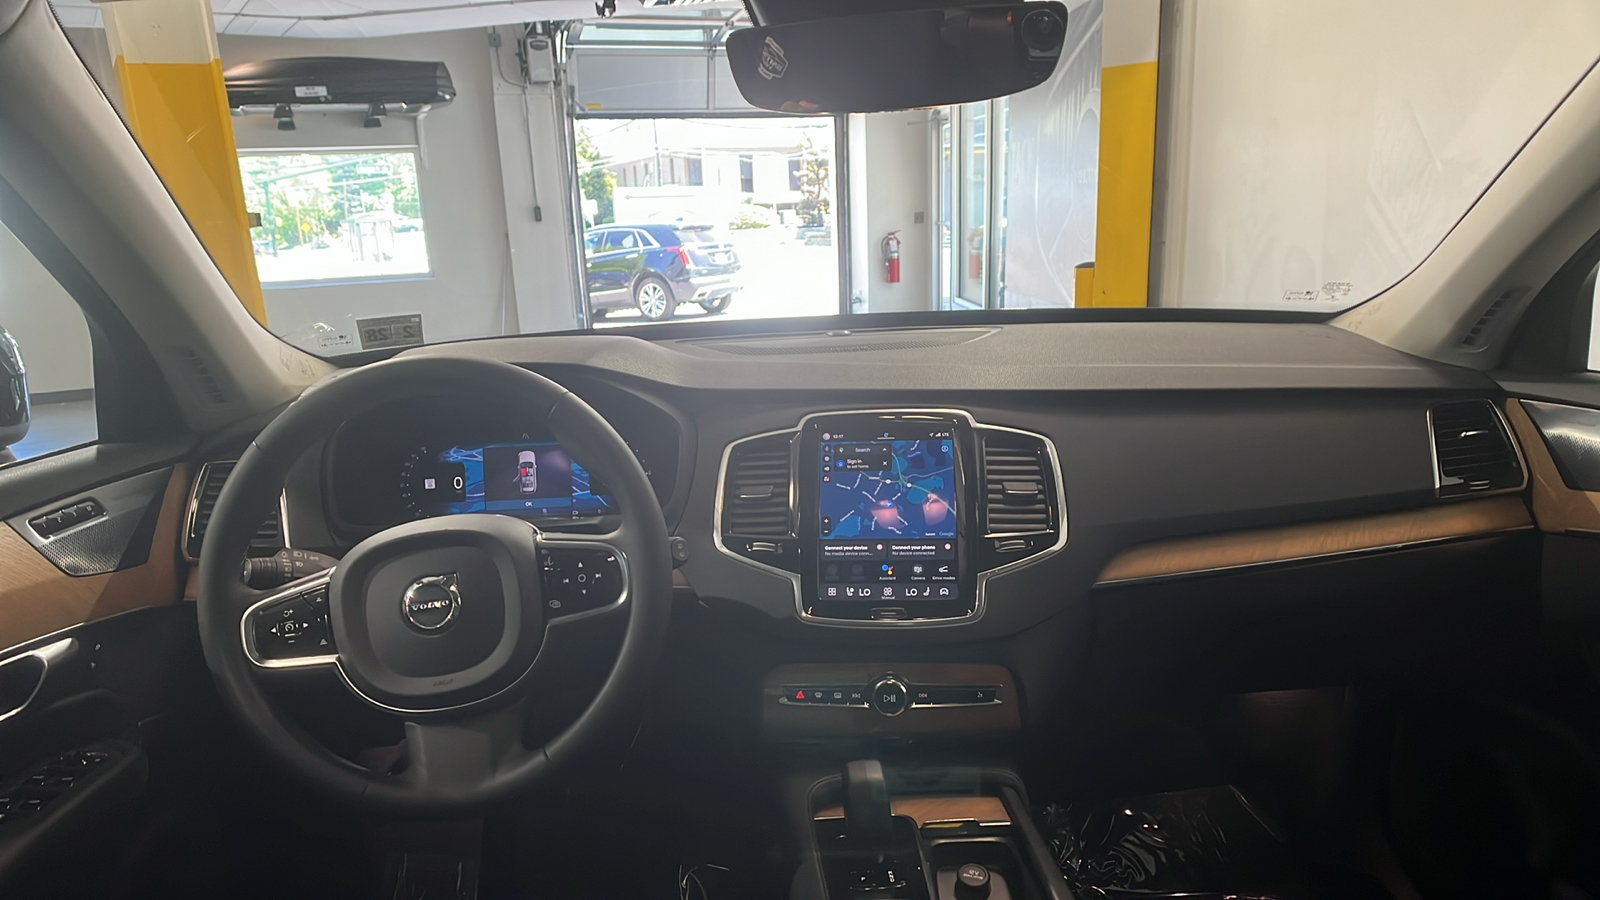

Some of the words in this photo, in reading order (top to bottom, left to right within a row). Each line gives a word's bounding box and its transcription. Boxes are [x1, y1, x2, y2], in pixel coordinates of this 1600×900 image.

[453, 476, 463, 490] 0
[859, 588, 871, 597] LO
[905, 587, 918, 597] LO
[411, 600, 449, 611] VOLVO
